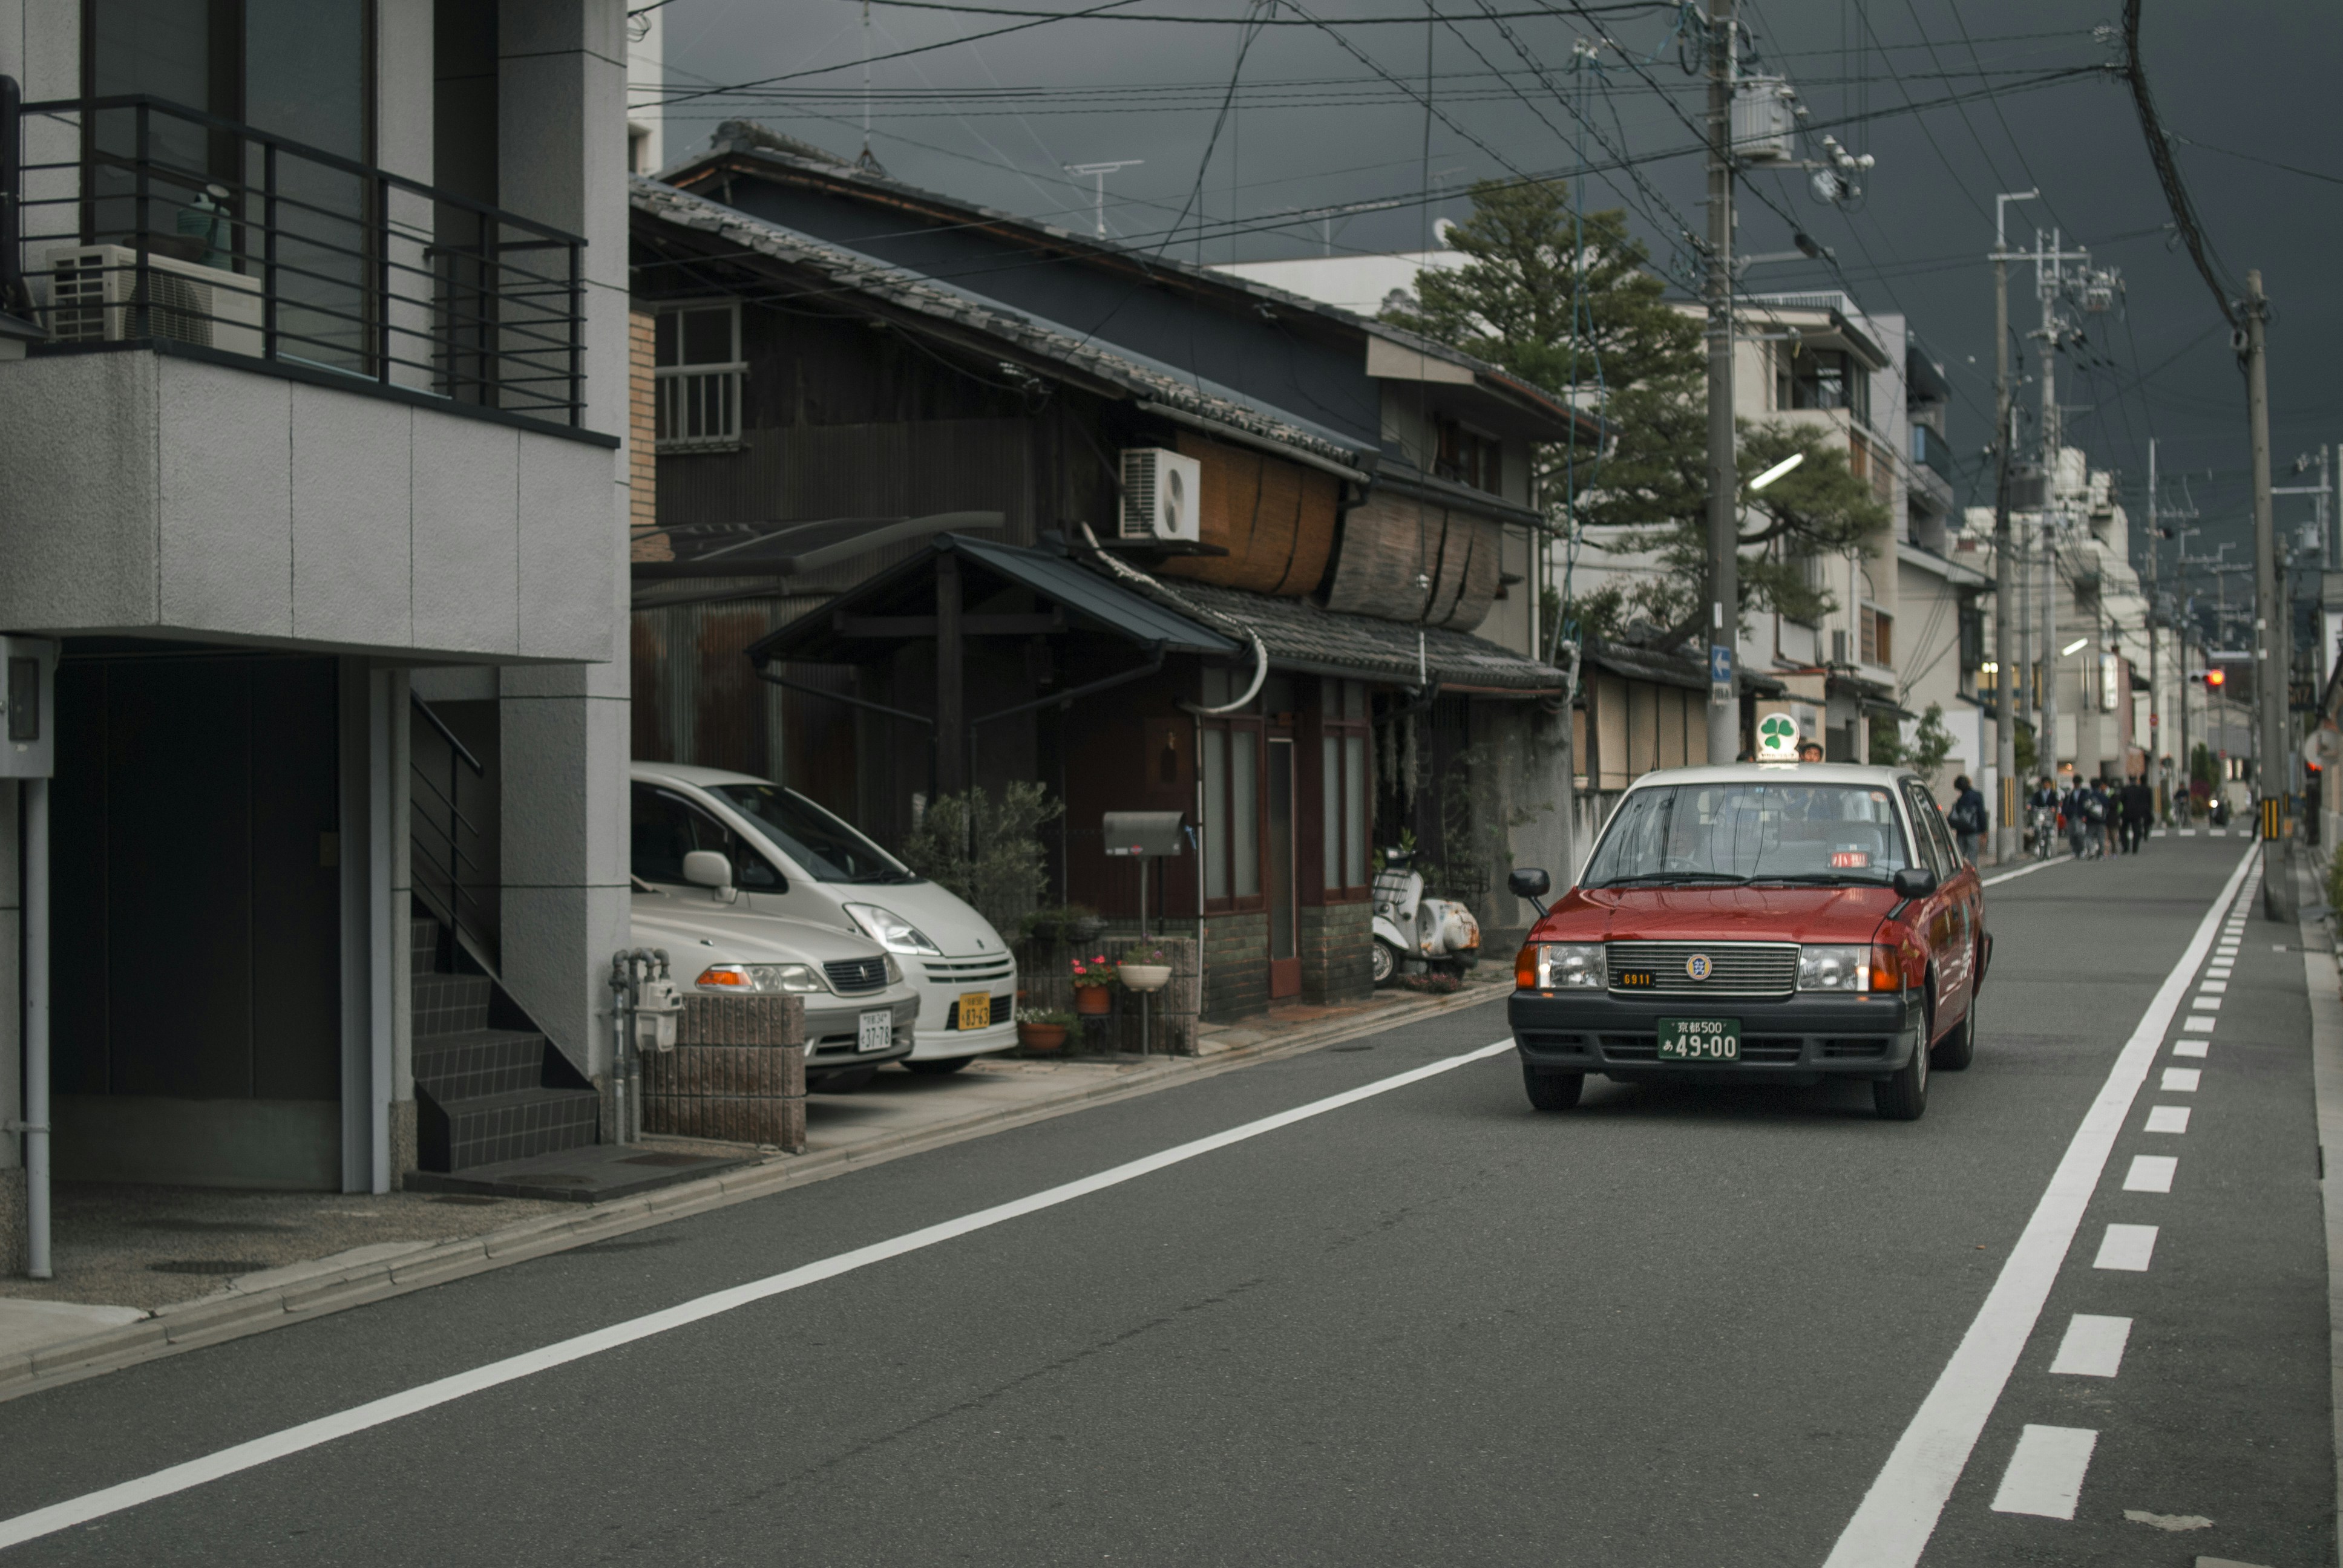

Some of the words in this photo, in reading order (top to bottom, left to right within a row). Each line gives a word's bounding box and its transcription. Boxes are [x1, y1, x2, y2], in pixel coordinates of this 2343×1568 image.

[1624, 973, 1650, 985] 6911
[1677, 1021, 1722, 1034] 京都500
[867, 1026, 890, 1048] 37-78
[1663, 1039, 1673, 1051] あ
[1676, 1034, 1736, 1057] 49-00
